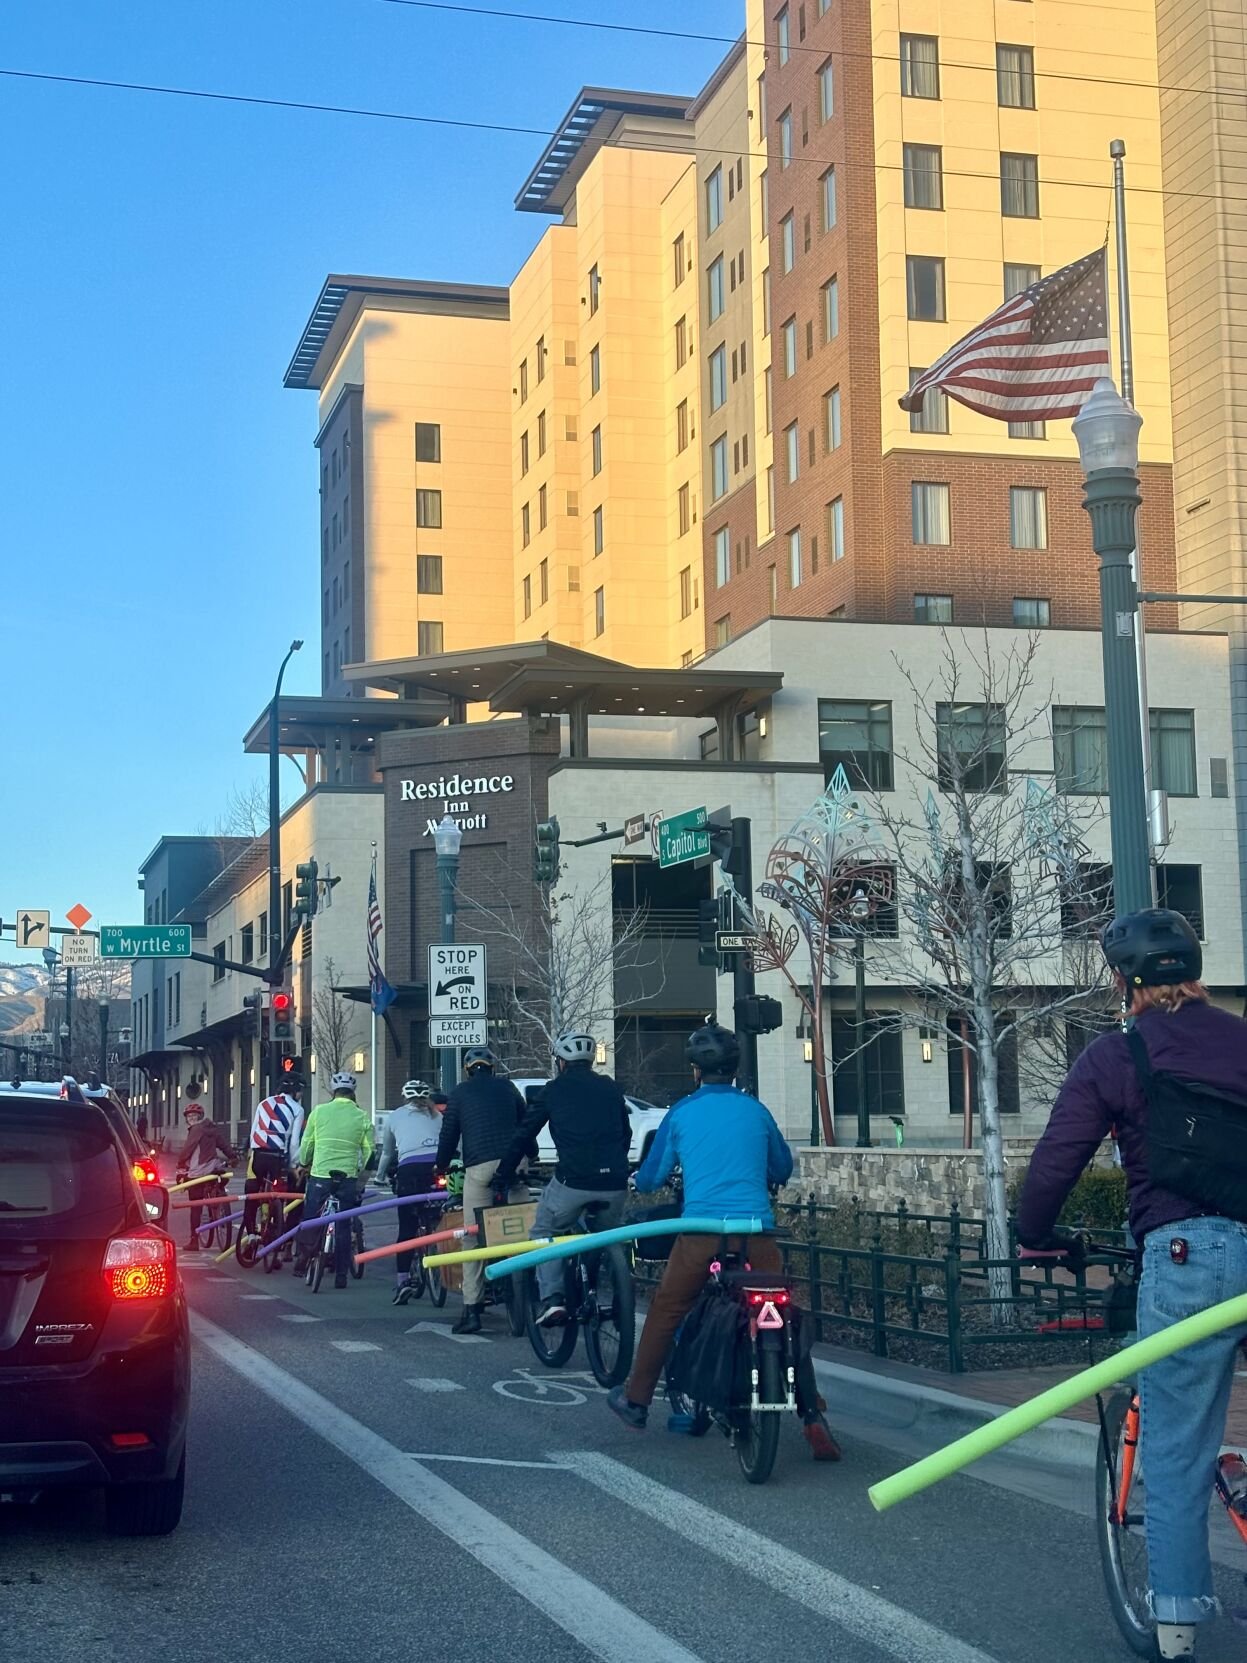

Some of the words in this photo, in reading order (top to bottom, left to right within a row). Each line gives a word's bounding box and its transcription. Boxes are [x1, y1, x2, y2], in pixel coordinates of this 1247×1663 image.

[400, 774, 513, 801] Residence
[443, 800, 470, 813] Inn
[661, 823, 670, 836] 400
[696, 811, 706, 825] 500
[662, 849, 666, 861] S
[666, 831, 696, 862] Capitol
[697, 836, 708, 850] Blvd
[106, 929, 123, 937] 700
[168, 928, 185, 936] 600
[106, 944, 115, 953] W
[120, 937, 171, 956] Myrtle
[176, 943, 185, 952] St
[722, 937, 739, 946] ONE
[77, 955, 93, 963] RED
[437, 950, 478, 964] STOP
[445, 966, 470, 975] HERE
[458, 985, 472, 994] ON
[450, 996, 480, 1010] RED
[441, 1021, 476, 1031] EXCEPT
[436, 1034, 481, 1044] BICYCLES
[35, 1323, 95, 1332] IMPREZA
